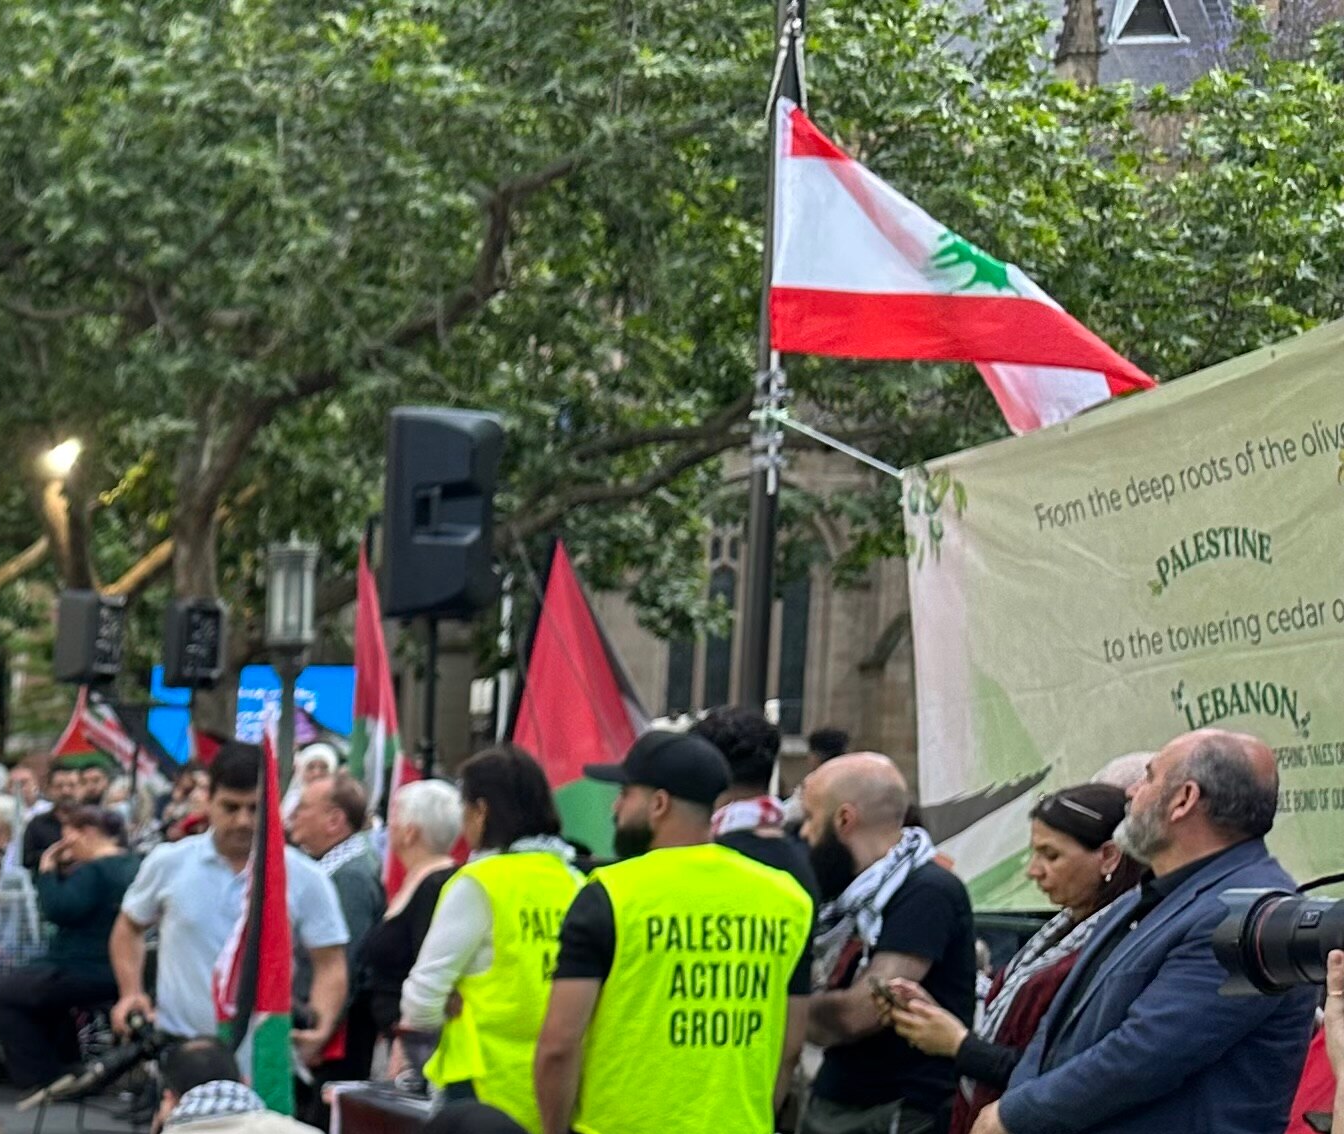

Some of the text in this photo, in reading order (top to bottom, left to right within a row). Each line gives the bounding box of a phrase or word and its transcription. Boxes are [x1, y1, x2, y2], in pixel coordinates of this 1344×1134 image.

[1034, 498, 1086, 531] From
[1088, 487, 1122, 517] the
[1125, 474, 1175, 505] deep
[1179, 456, 1233, 493] roots
[1236, 439, 1257, 475] of
[1258, 436, 1297, 470] the
[1155, 526, 1273, 588] PALESTINE
[1103, 597, 1344, 664] to the towering cedar o
[1183, 680, 1300, 731] LEBANON
[646, 914, 791, 956] PALESTINE
[669, 962, 771, 1000] ACTION
[669, 1009, 763, 1049] GROUP
